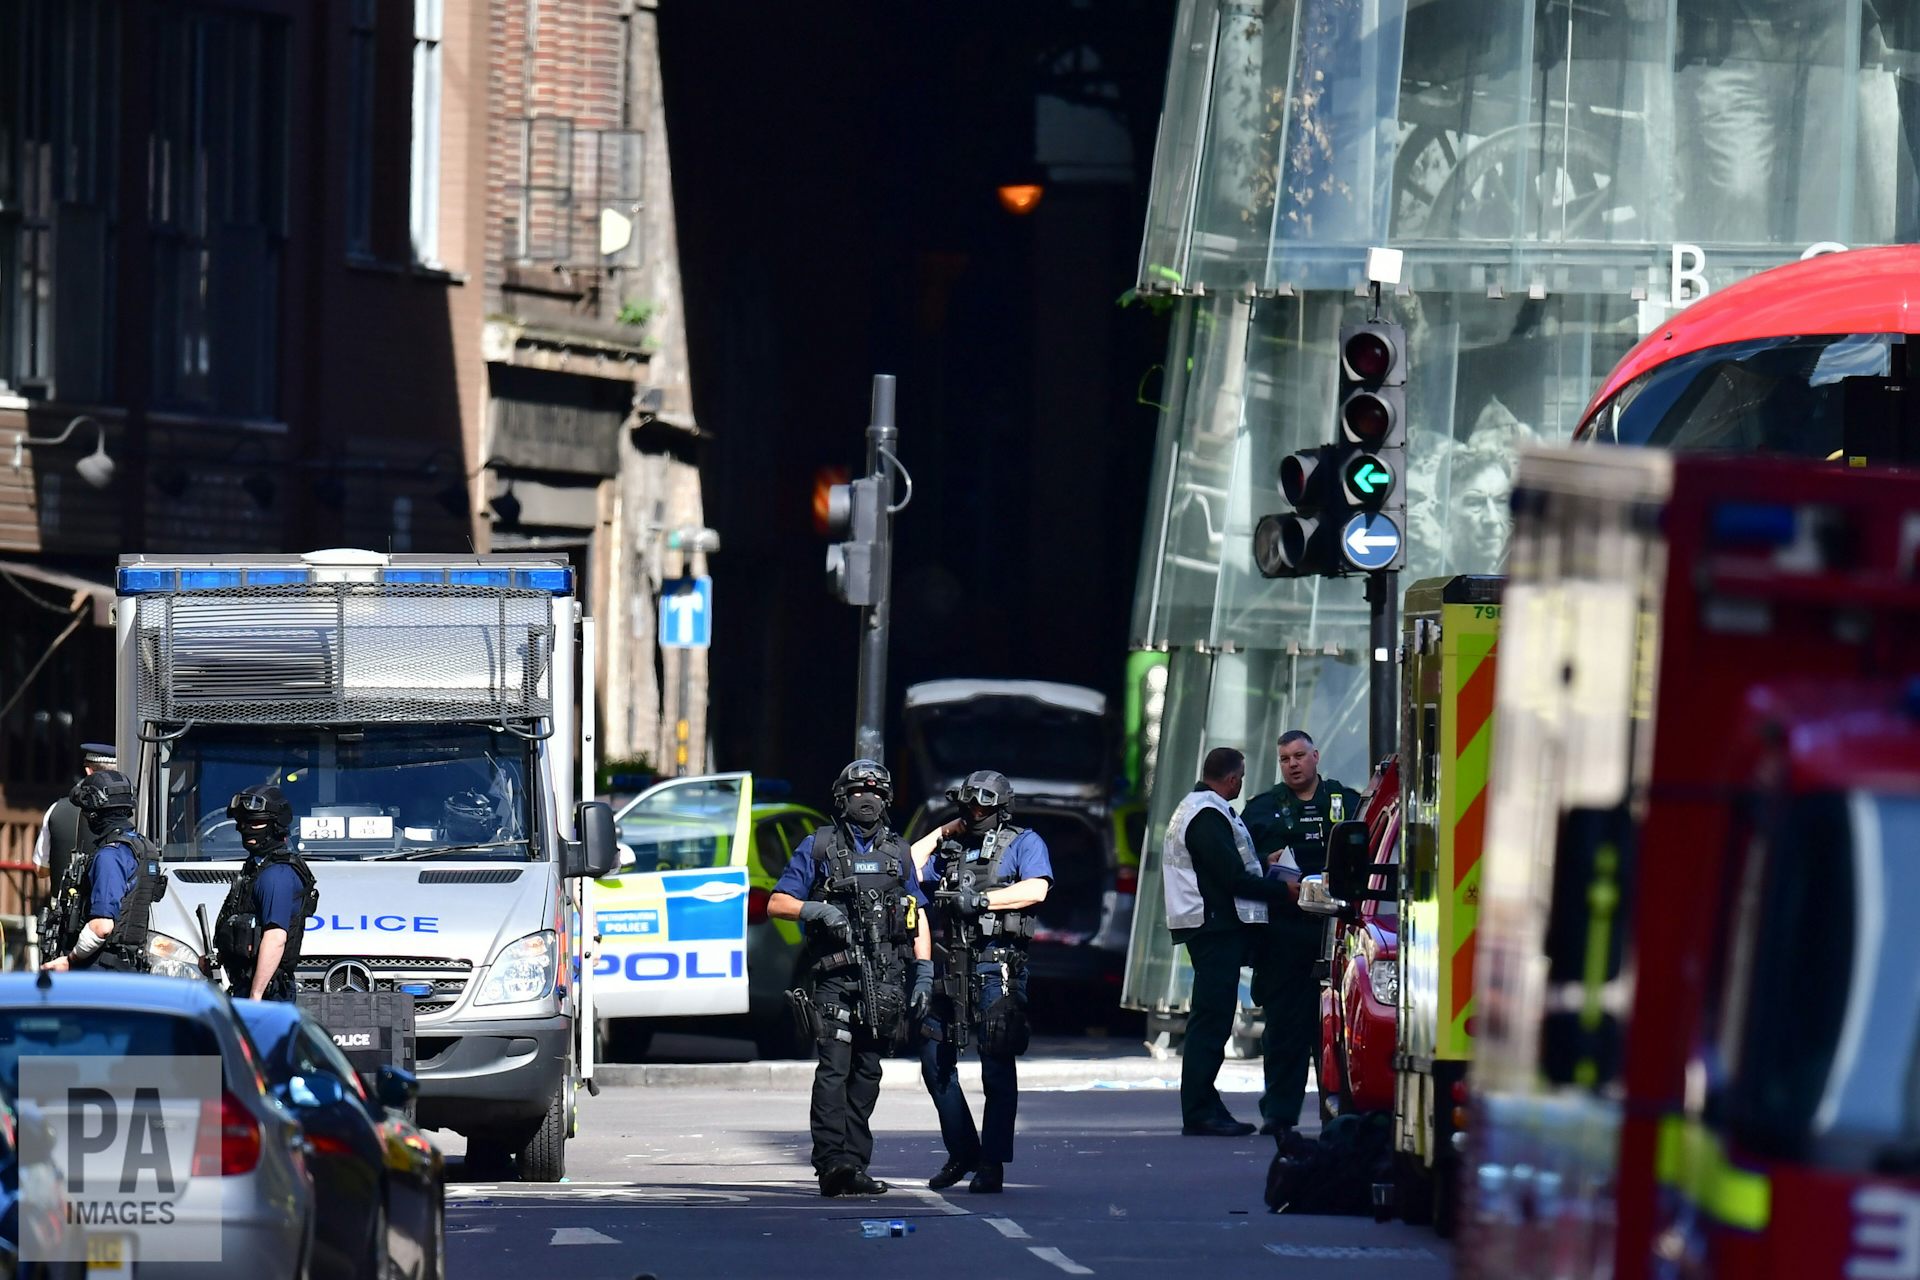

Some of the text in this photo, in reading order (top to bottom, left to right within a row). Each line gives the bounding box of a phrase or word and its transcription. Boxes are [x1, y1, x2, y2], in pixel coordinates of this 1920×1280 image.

[317, 819, 329, 828] U
[308, 829, 338, 839] 431
[856, 864, 878, 872] POLICE
[304, 915, 439, 933] OLICE
[605, 921, 649, 933] POLICE
[333, 1033, 371, 1047] OLICE
